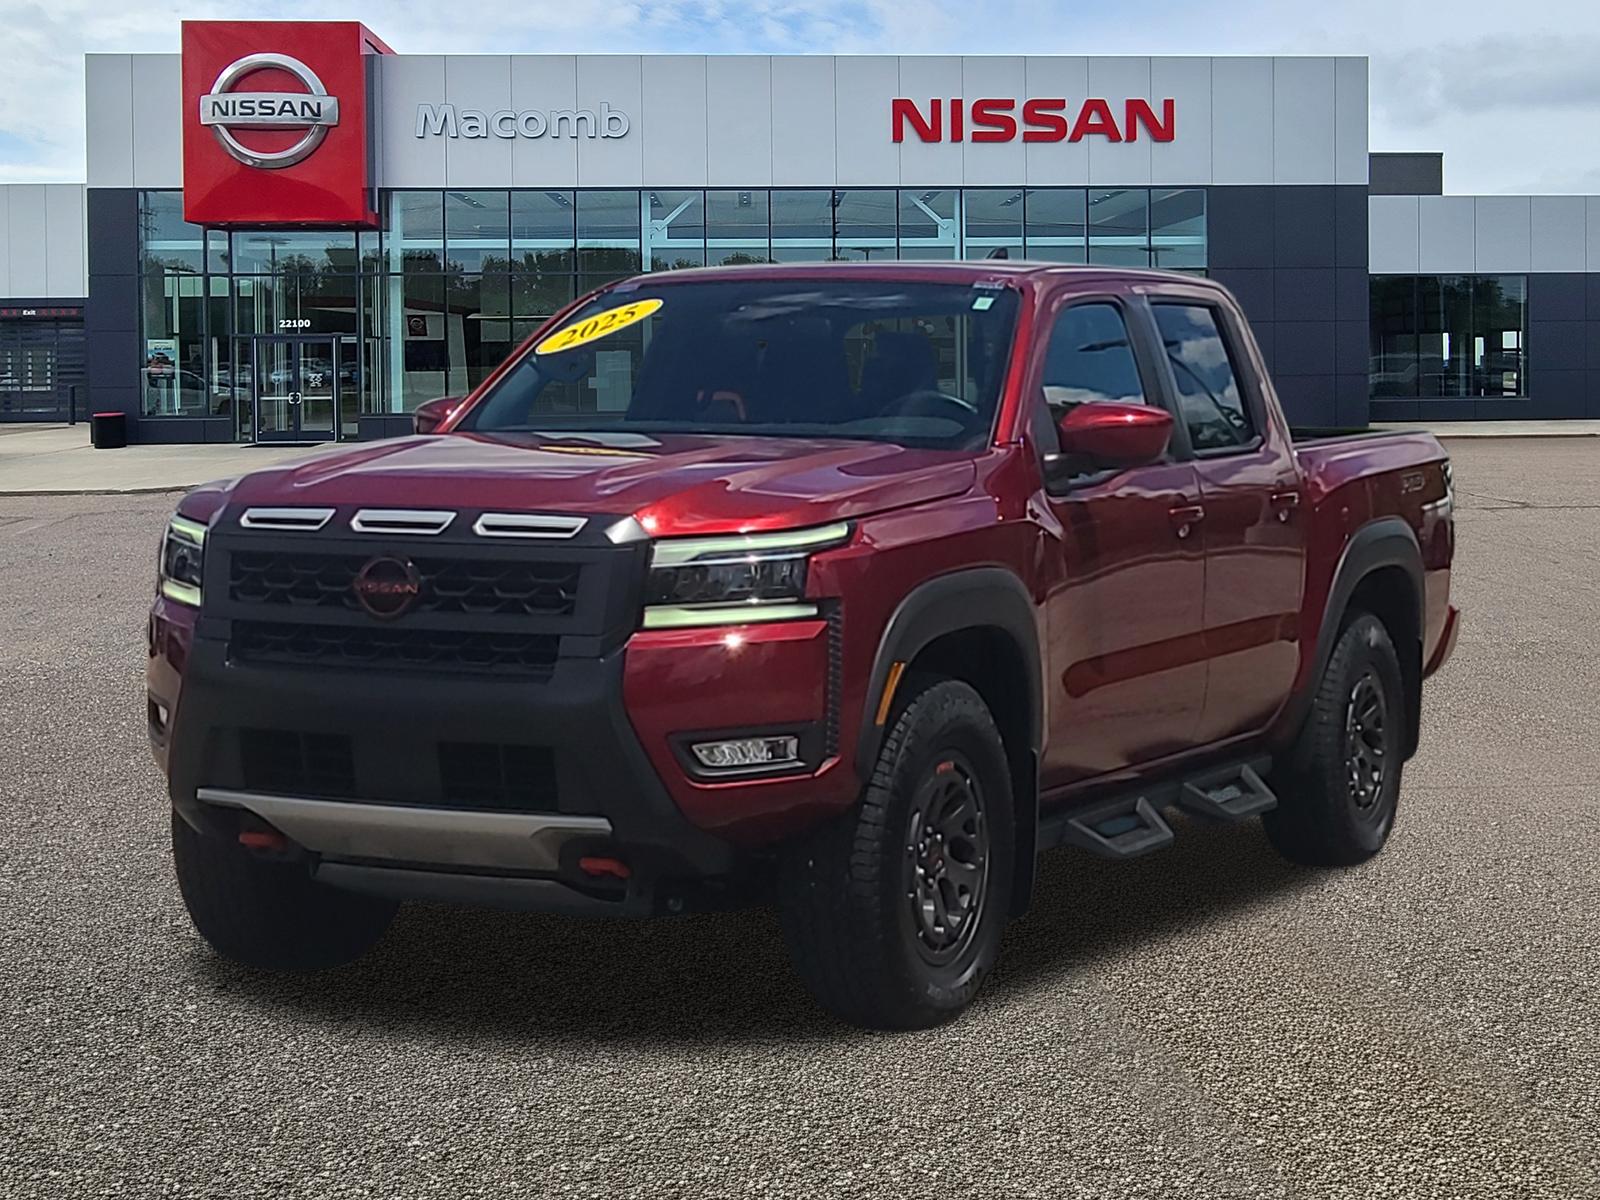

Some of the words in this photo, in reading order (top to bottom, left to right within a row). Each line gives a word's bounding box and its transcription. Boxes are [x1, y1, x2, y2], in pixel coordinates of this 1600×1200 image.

[211, 99, 322, 118] NISSAN
[415, 101, 630, 139] Macomb
[891, 97, 1176, 143] NISSAN
[279, 319, 312, 328] 22100
[558, 304, 639, 348] 2025
